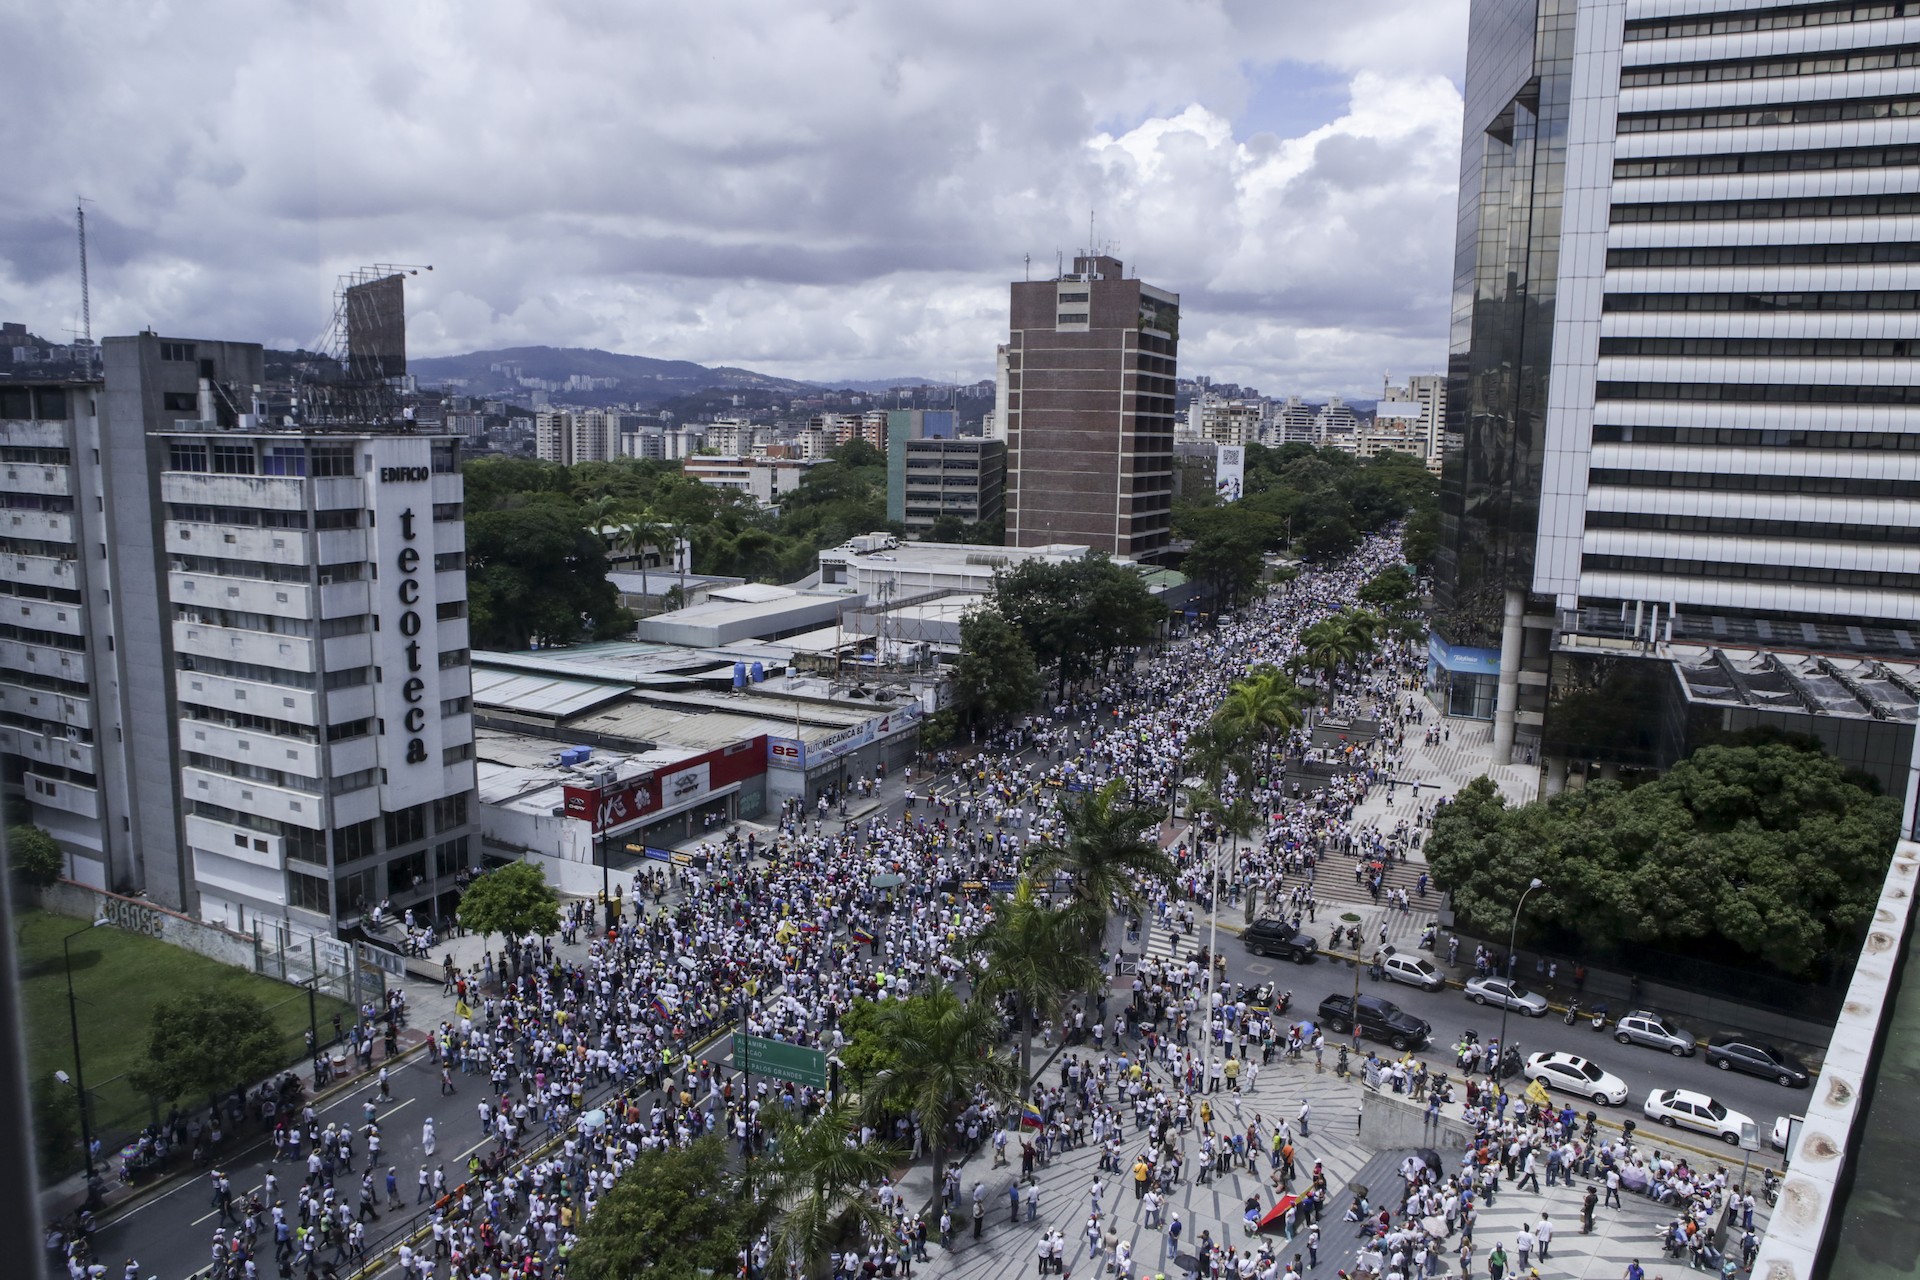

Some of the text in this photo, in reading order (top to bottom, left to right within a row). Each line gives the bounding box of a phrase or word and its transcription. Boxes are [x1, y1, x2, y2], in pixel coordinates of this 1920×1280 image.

[380, 466, 429, 482] EDIFICIO
[398, 508, 428, 765] tecoteca
[806, 726, 864, 755] AUTOMECANICA 82
[772, 745, 799, 758] 82
[737, 1038, 767, 1049] ALAMIRA
[752, 1063, 772, 1073] PALOS
[773, 1068, 802, 1080] GRANDES
